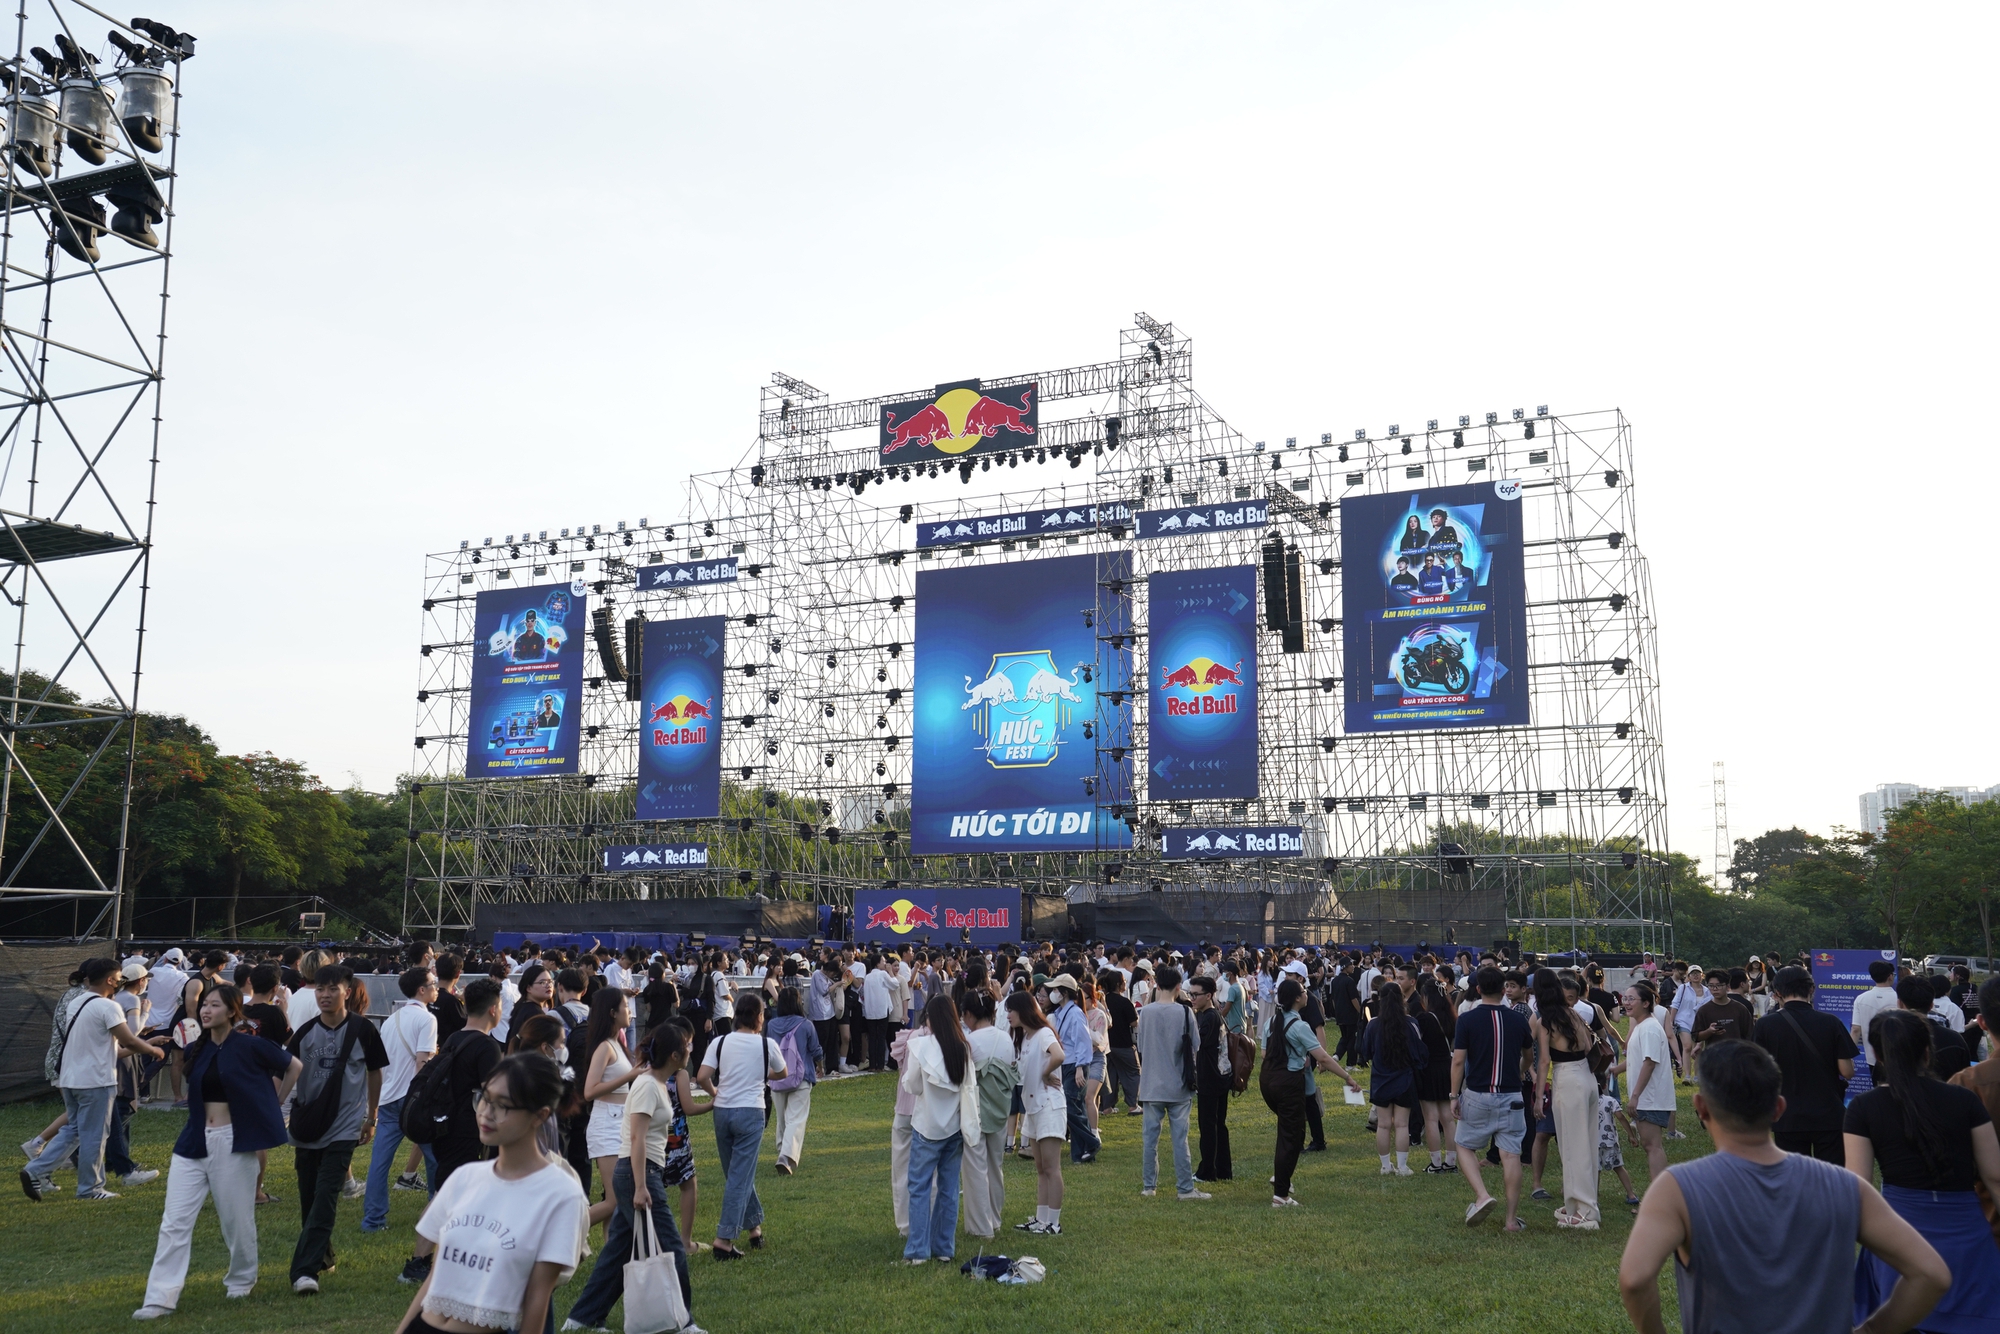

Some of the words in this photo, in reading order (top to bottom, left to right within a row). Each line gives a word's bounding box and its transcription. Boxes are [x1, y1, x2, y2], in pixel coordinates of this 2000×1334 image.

[1499, 484, 1516, 496] tcp
[978, 520, 1001, 536] Red
[1002, 516, 1027, 532] Bull
[1214, 508, 1244, 526] Red
[696, 566, 720, 581] Red
[1382, 610, 1396, 619] ÂM
[1397, 609, 1422, 618] NHẠC
[1422, 606, 1454, 615] HOÀNH
[1456, 603, 1486, 612] TRÁNG
[1166, 695, 1200, 716] Red
[1202, 693, 1238, 715] Bull
[653, 728, 679, 746] Red
[680, 726, 707, 745] Bull
[997, 716, 1044, 745] HÚC
[1005, 746, 1035, 760] FEST
[950, 809, 1007, 837] HÚC
[1012, 807, 1058, 836] TỚI
[1060, 811, 1092, 834] ĐI
[1245, 834, 1276, 851] Red
[665, 849, 688, 864] Red
[945, 908, 976, 928] Red
[977, 907, 1009, 928] Bull
[442, 1246, 494, 1274] LEAGUE
